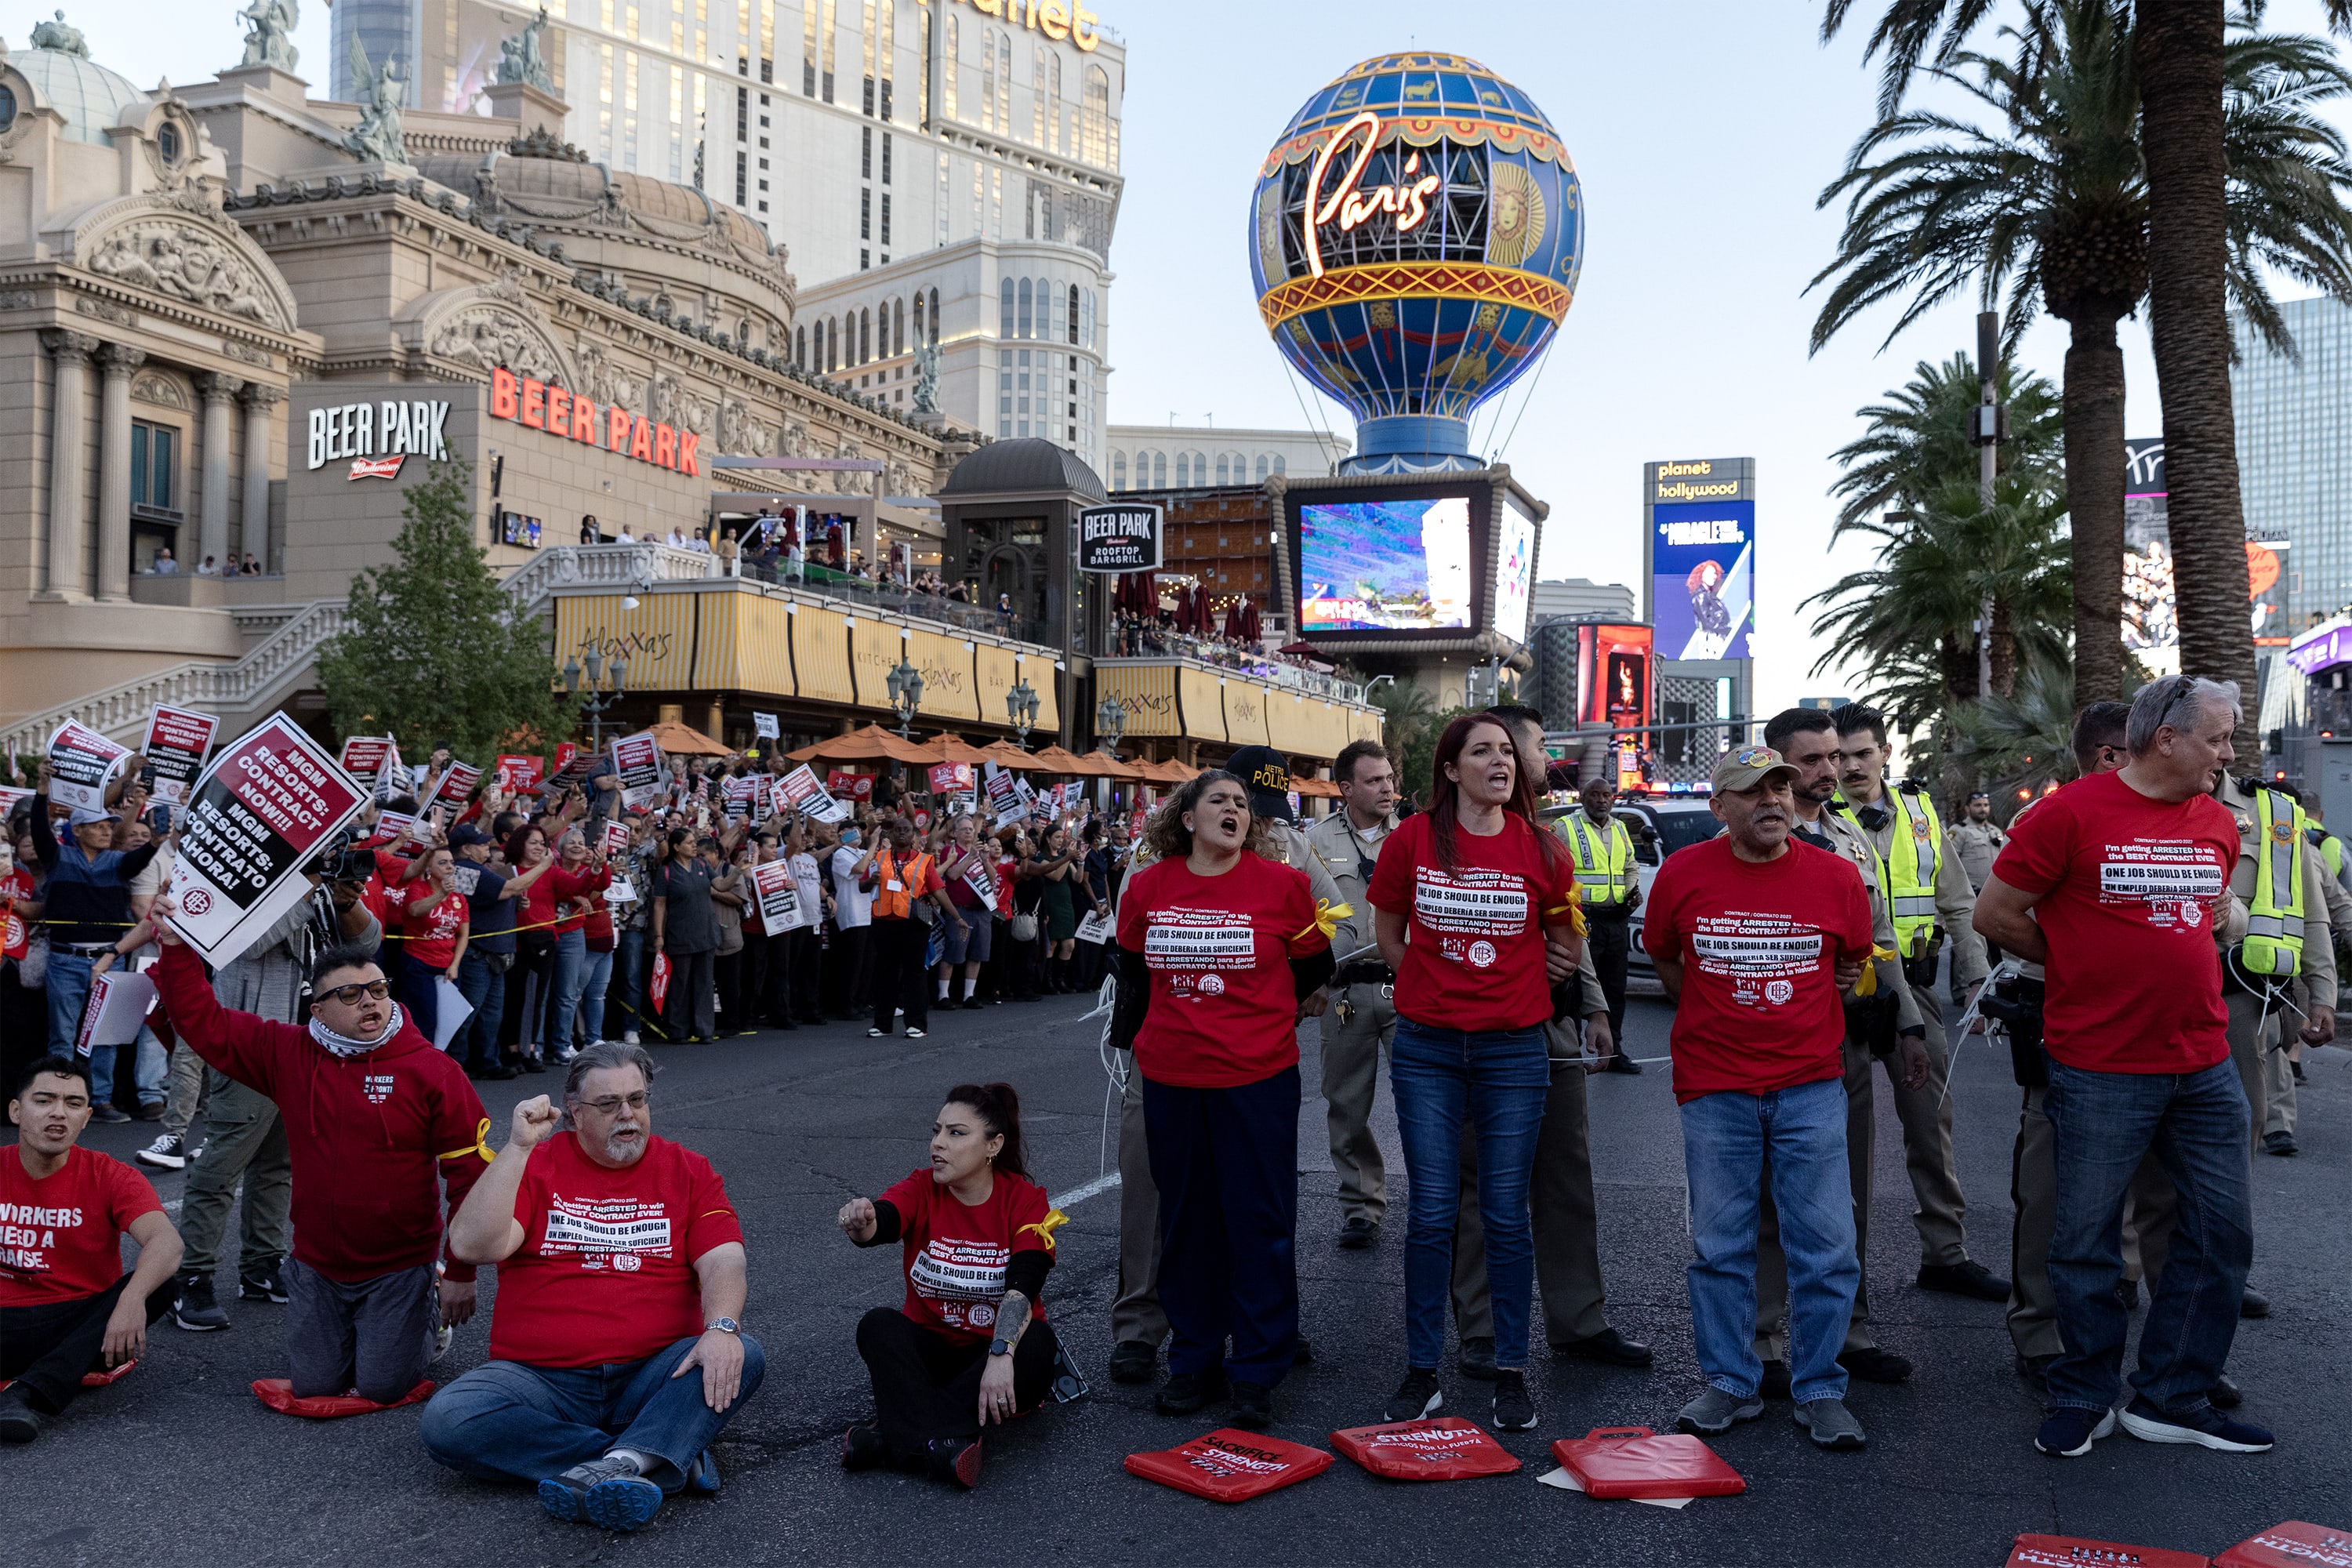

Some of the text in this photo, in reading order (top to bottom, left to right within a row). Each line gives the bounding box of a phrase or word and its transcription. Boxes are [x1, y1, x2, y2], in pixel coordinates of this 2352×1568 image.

[916, 0, 1099, 52] net
[1305, 111, 1439, 279] Paris
[490, 368, 699, 476] BEER PARK
[308, 400, 448, 470] BEER PARK
[352, 462, 400, 474] Budweiser
[1659, 461, 1711, 481] planet
[1659, 481, 1737, 500] hollywood
[1085, 513, 1151, 542] BEER PARK
[1095, 546, 1139, 556] ROOFTOP
[171, 715, 199, 725] CAESARS
[158, 725, 207, 741] CONTRACT
[165, 735, 194, 746] NOW!!!
[620, 750, 652, 760] CONTRACT
[59, 771, 92, 782] AHORA!
[286, 749, 327, 789] MGM
[1265, 764, 1284, 775] METRO
[254, 746, 330, 816] RESORTS:
[1253, 770, 1288, 791] POLICE
[238, 756, 322, 831] CONTRACT
[238, 782, 294, 831] NOW!!!
[227, 803, 271, 843] MGM
[198, 799, 274, 871] RESORTS:
[1577, 829, 1590, 865] POLICE
[180, 834, 241, 891] AHORA!
[2106, 868, 2125, 877] ONE
[2128, 869, 2144, 878] JOB
[2147, 869, 2180, 878] SHOULD
[2118, 884, 2147, 892] EMPLEO
[1428, 890, 1525, 905] JOB SHOULD BE ENOUGH
[1422, 905, 1443, 913] EMPLEO
[1439, 918, 1490, 927] ARRESTANDO
[1711, 917, 1740, 927] getting
[1171, 931, 1203, 939] SHOULD
[1205, 931, 1215, 939] BE
[1697, 938, 1711, 949] ONE
[1713, 940, 1729, 949] JOB
[1732, 941, 1767, 950] SHOULD
[1784, 940, 1819, 949] ENOUGH
[0, 1203, 82, 1227] WORKERS
[551, 1215, 666, 1235] ONE JOB SHOULD BE ENOUGH
[0, 1225, 55, 1248] EED A
[558, 1232, 583, 1240] EMPLEO
[629, 1236, 666, 1247] SUFICIENTE
[930, 1240, 955, 1254] getting
[930, 1248, 994, 1264] BEST CONTRACT
[920, 1275, 941, 1287] EMPLEO
[943, 1267, 975, 1279] SHOULD
[938, 1290, 986, 1300] ARRESTANDO
[1377, 1428, 1480, 1443] STRENGTH
[1202, 1436, 1283, 1461] SACRIFICE
[1203, 1449, 1290, 1471] STRENGTH
[2253, 1537, 2350, 1566] ENGTH
